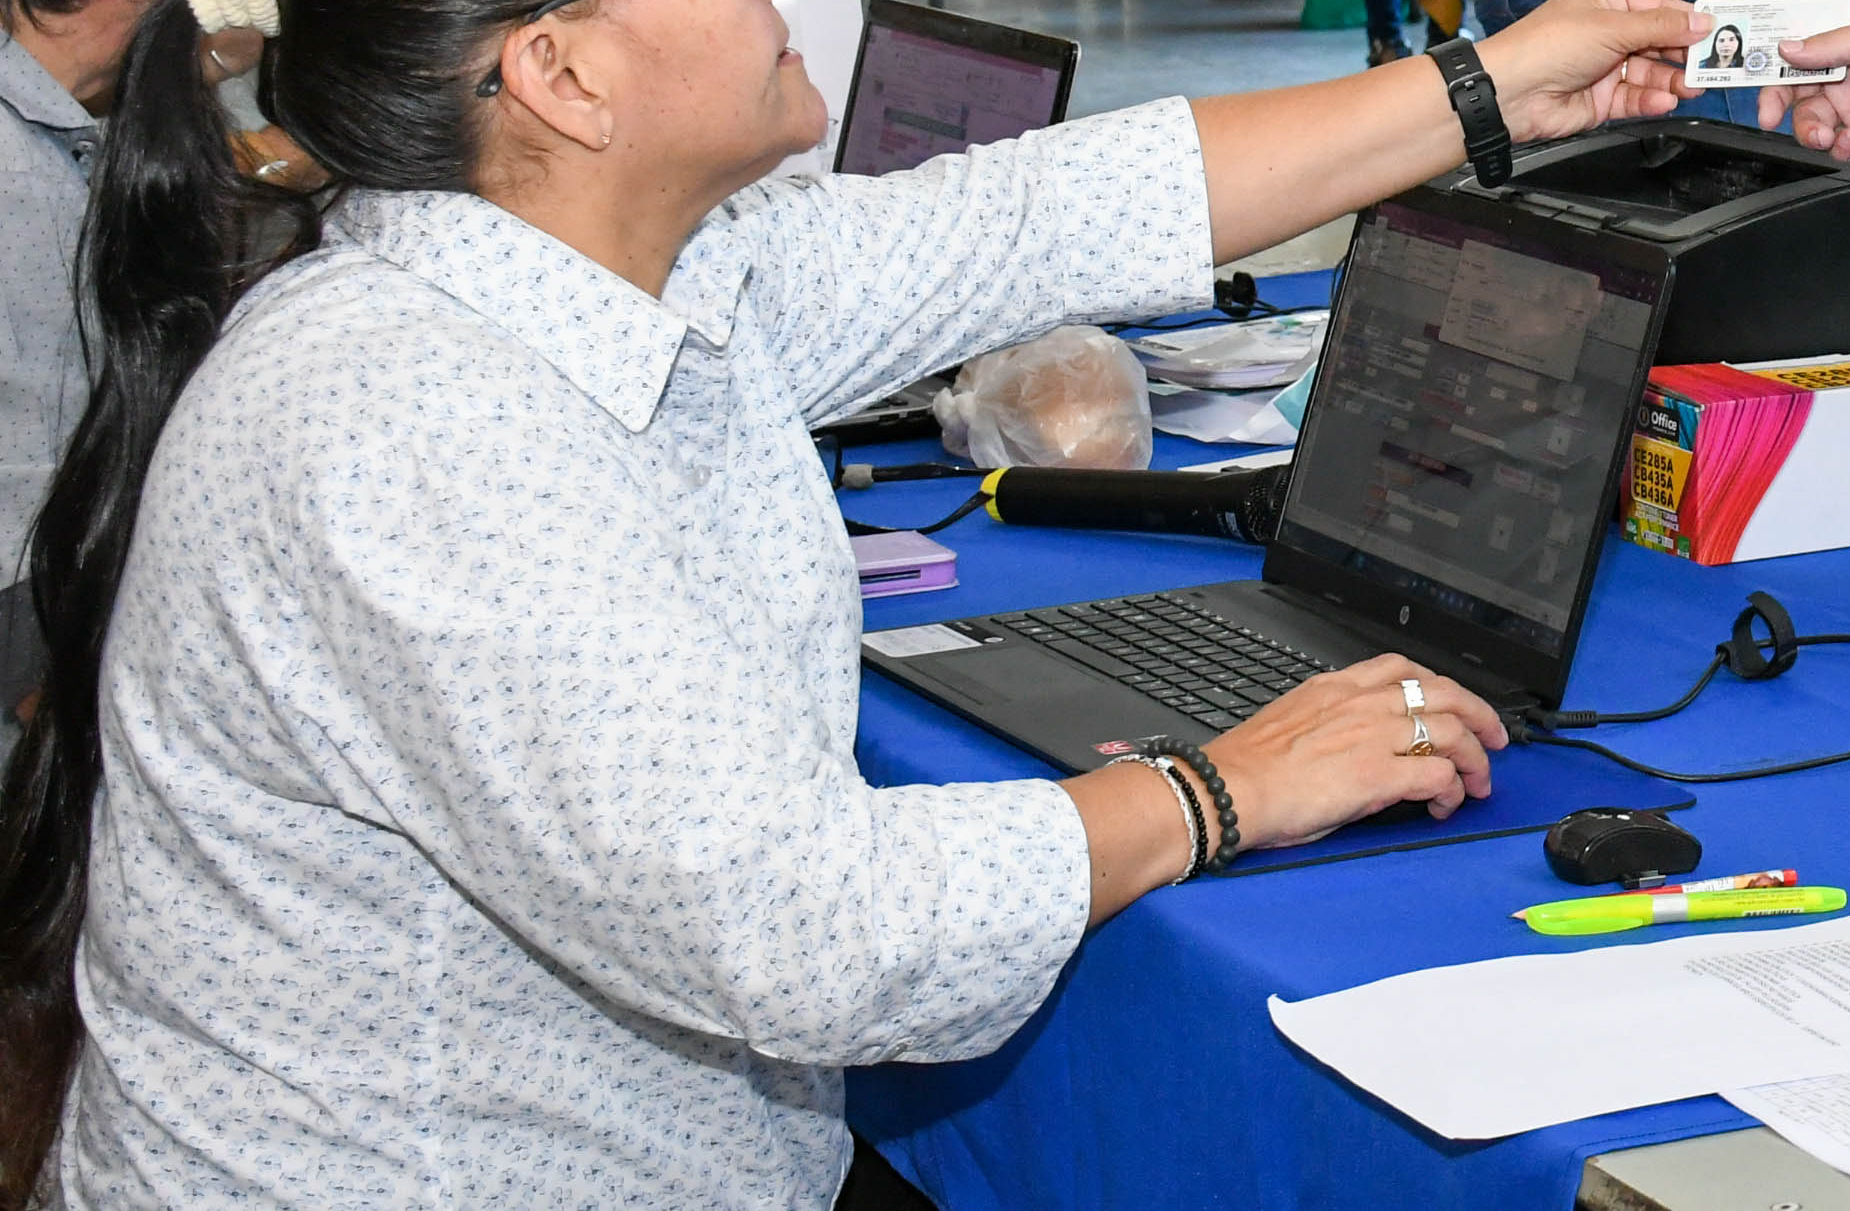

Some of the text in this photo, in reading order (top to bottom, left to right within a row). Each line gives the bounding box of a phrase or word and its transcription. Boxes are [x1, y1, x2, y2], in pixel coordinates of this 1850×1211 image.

[1651, 411, 1677, 431] Office
[1634, 448, 1674, 474] CE285A
[1634, 465, 1674, 492] CB435A
[1634, 482, 1674, 508] CB436A
